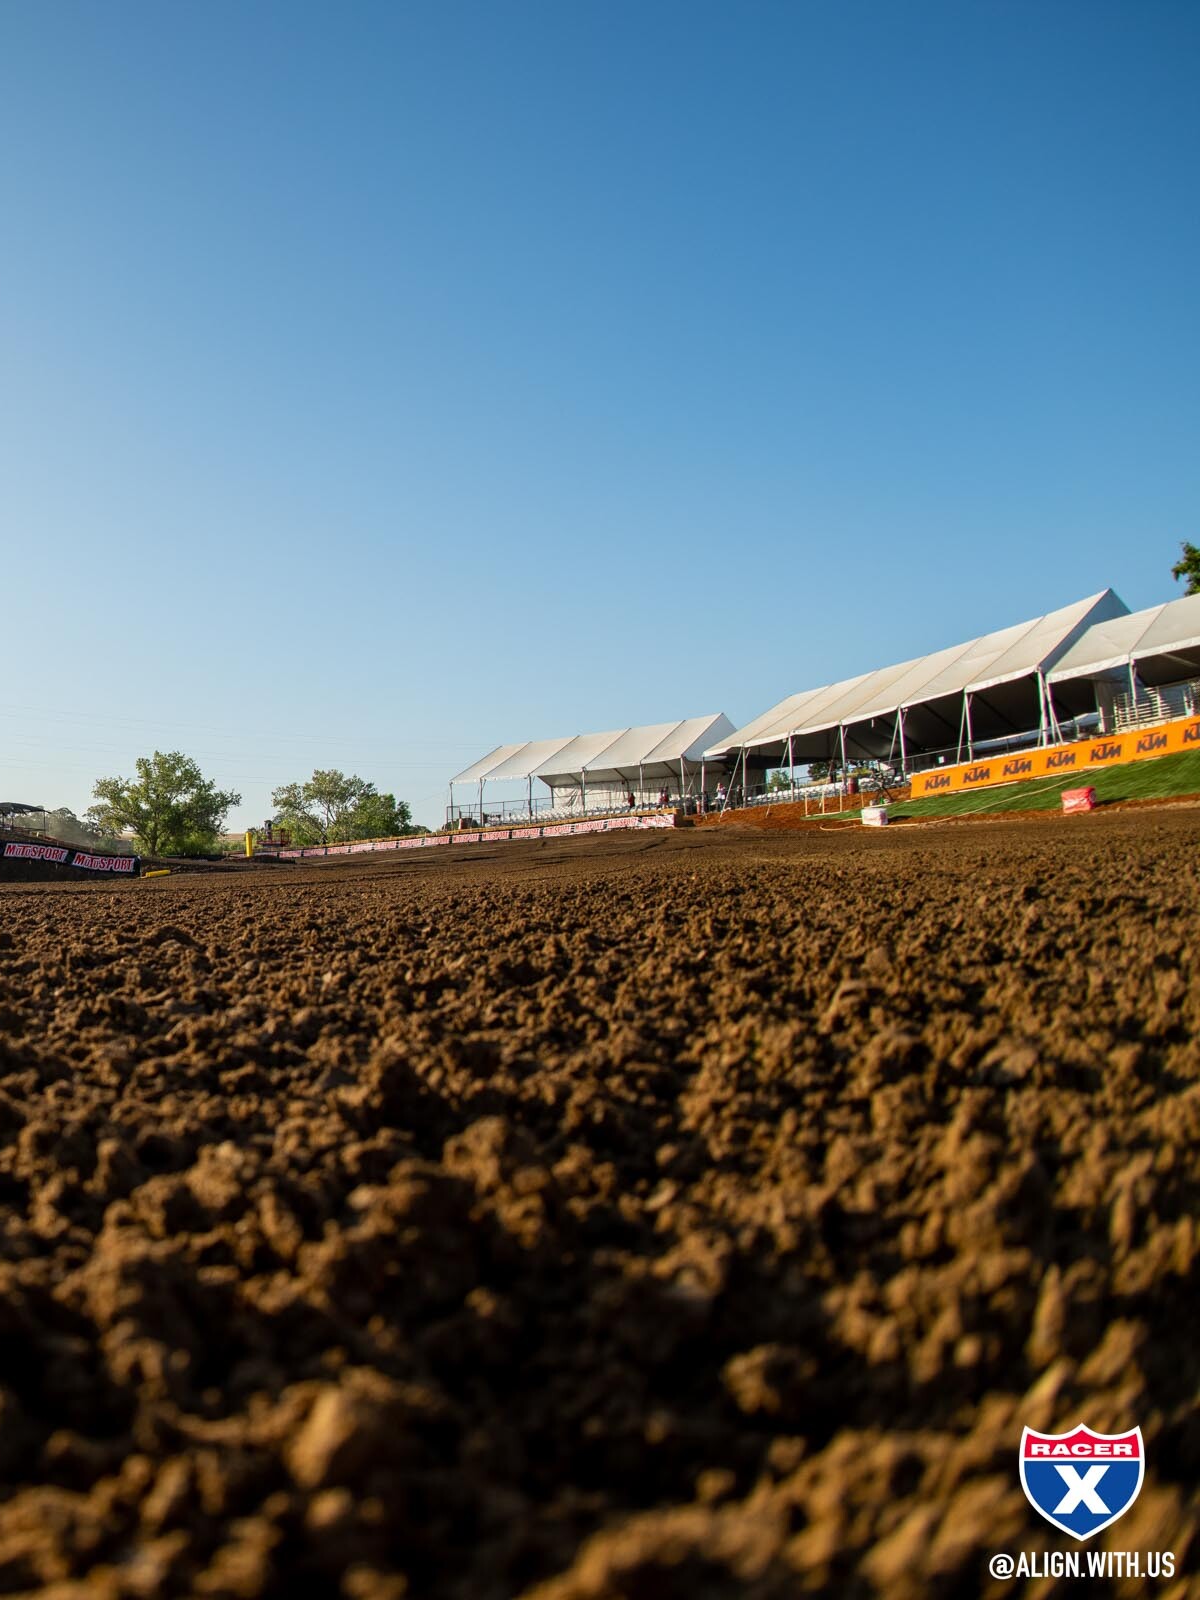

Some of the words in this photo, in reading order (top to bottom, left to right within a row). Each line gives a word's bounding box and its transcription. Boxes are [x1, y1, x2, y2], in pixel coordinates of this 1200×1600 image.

[925, 774, 950, 790] KTM
[963, 766, 991, 783] KTM
[1003, 758, 1032, 776] KTM
[1046, 751, 1076, 768] KTM
[1090, 742, 1121, 761] KTM
[1136, 732, 1167, 753] KTM
[1183, 722, 1200, 743] KT
